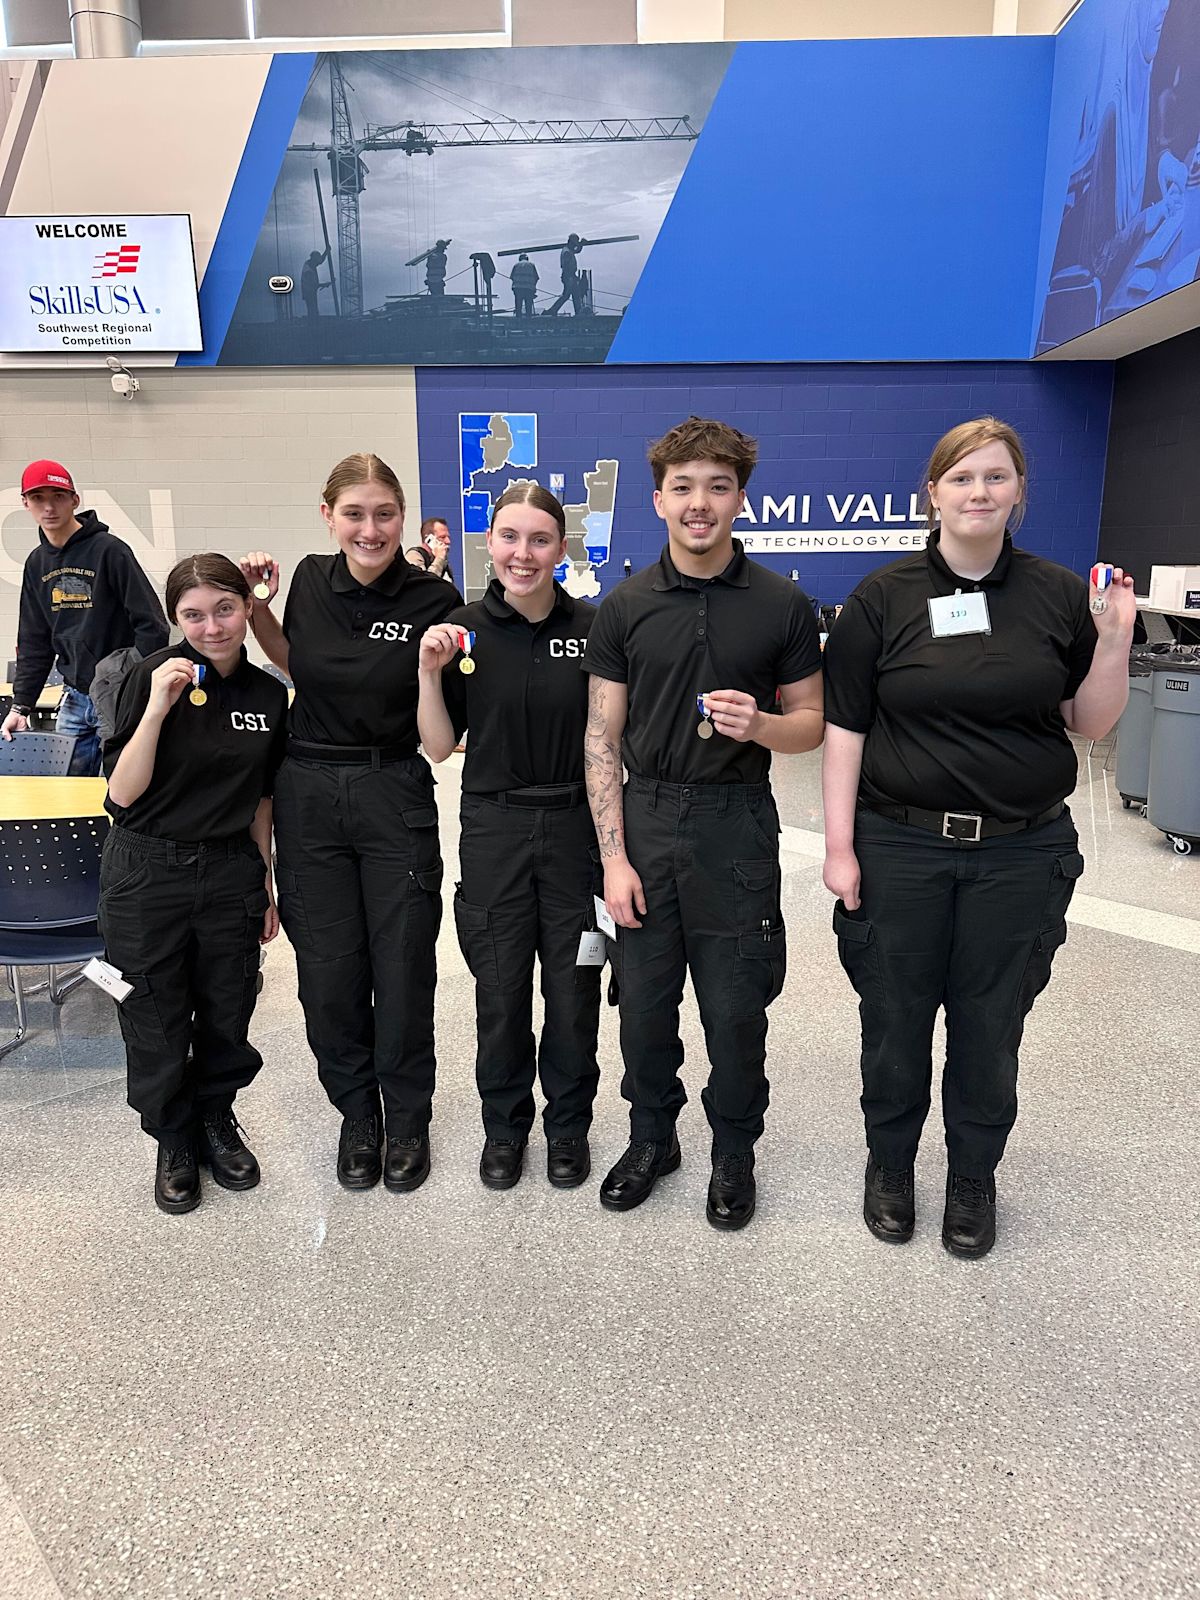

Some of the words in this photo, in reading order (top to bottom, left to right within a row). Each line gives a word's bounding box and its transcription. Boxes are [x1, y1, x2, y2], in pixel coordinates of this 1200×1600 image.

[36, 224, 127, 238] WELCOME
[29, 285, 149, 315] SkillsUSA
[38, 323, 99, 333] Southwest
[102, 323, 152, 334] Regional
[62, 336, 131, 347] Competition
[732, 495, 811, 524] AMI
[826, 493, 941, 523] VALL
[763, 536, 890, 547] TECHNOLOGY
[899, 535, 929, 546] CE
[368, 621, 413, 642] CSI
[549, 638, 588, 658] CSI
[1166, 680, 1188, 691] ULINE
[230, 711, 270, 732] CSI
